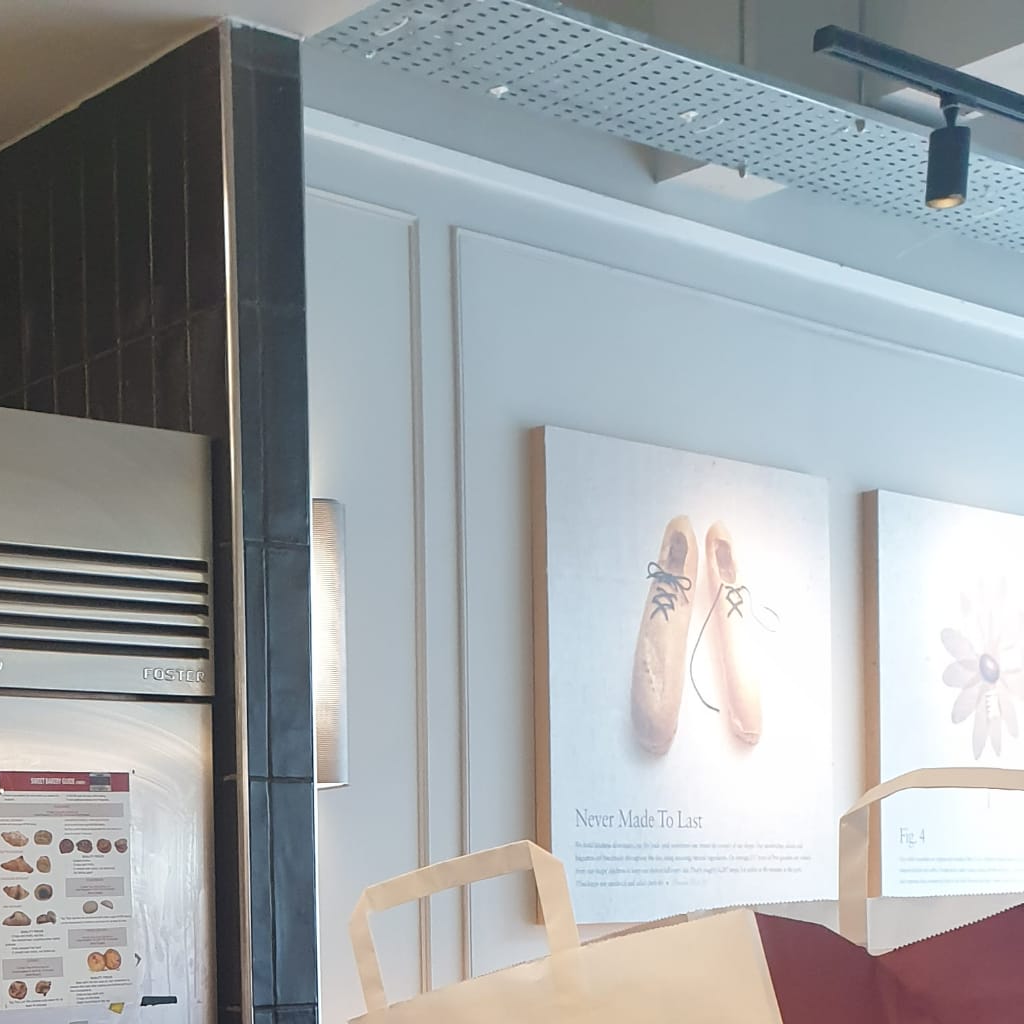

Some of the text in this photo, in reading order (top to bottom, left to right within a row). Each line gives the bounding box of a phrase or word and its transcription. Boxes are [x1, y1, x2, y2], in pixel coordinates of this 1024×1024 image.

[143, 667, 206, 683] FOSTER
[575, 808, 703, 829] Never Made To Last
[917, 828, 926, 844] 4
